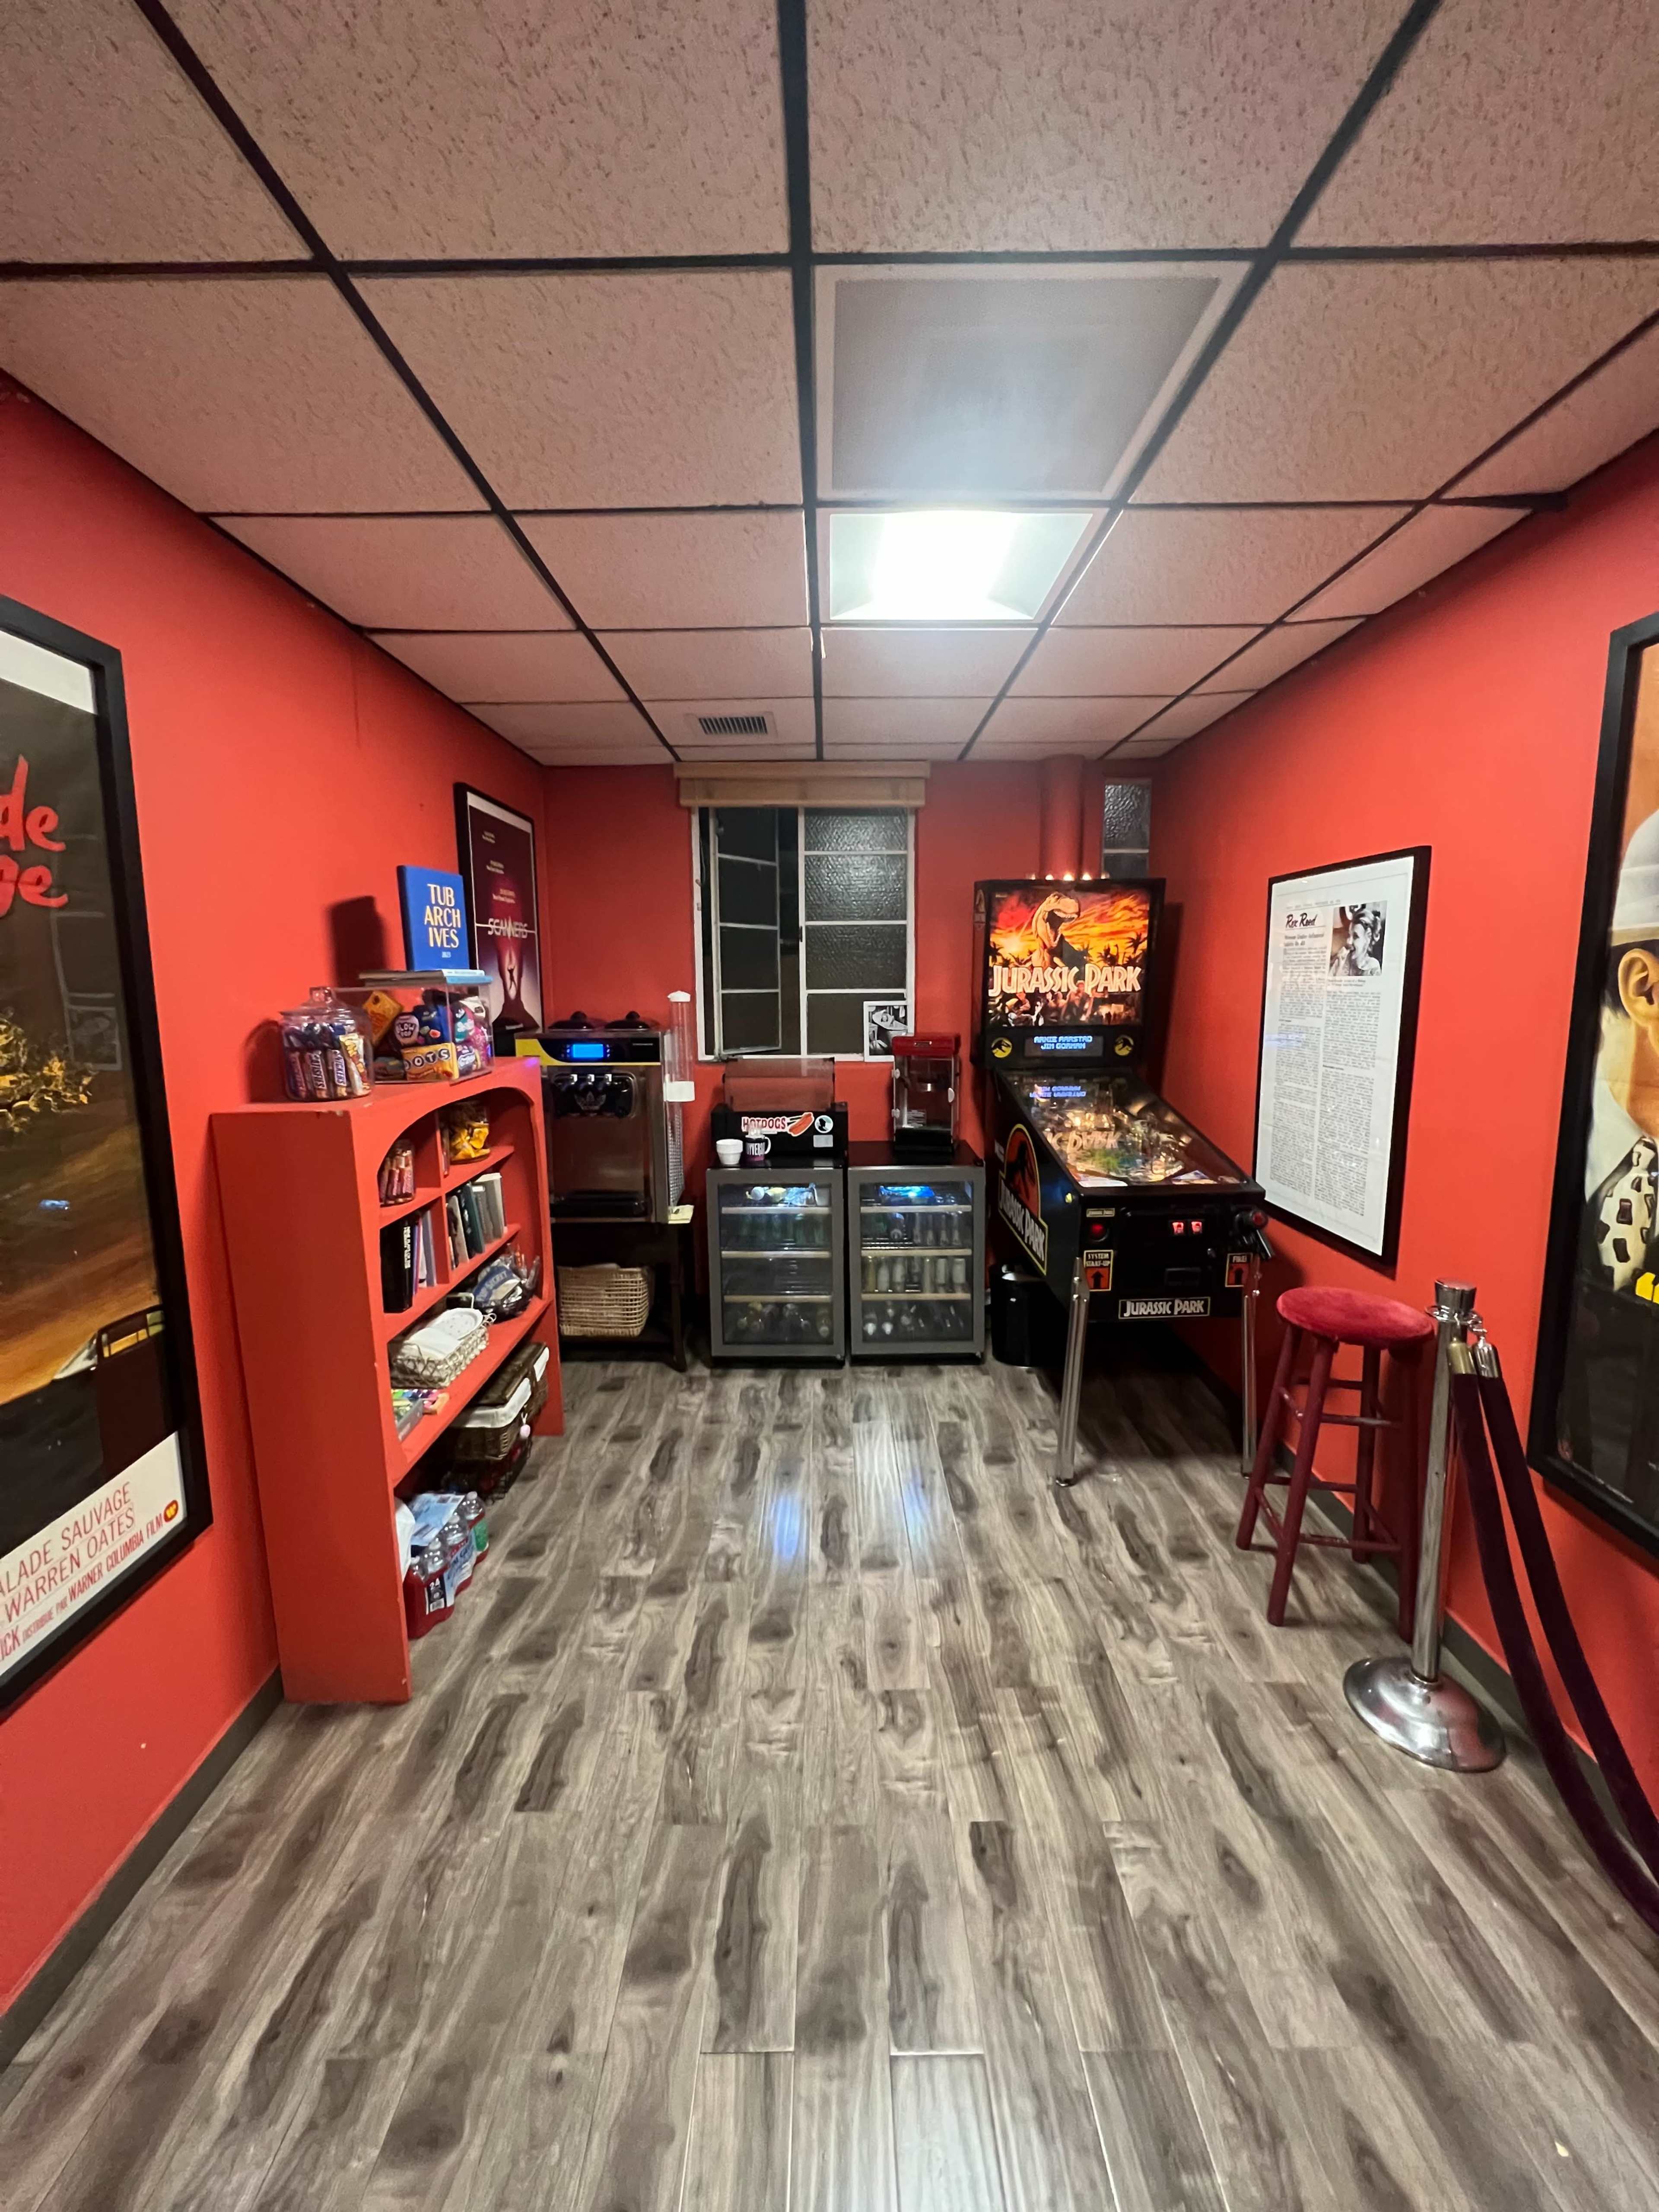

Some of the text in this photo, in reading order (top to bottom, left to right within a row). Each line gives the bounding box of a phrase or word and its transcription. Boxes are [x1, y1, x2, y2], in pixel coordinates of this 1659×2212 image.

[427, 884, 455, 907] TUB
[424, 906, 461, 928] ARCH
[429, 927, 459, 948] IVES
[988, 963, 1142, 997] JURASSIC PARK
[1123, 1299, 1205, 1317] JURASSIC PARK
[61, 1481, 131, 1551] SAUVAGE
[5, 1507, 134, 1623] WARREN OATES
[68, 1561, 104, 1602] WARNER
[106, 1529, 144, 1572] COLUMBIA
[146, 1513, 163, 1539] FILM
